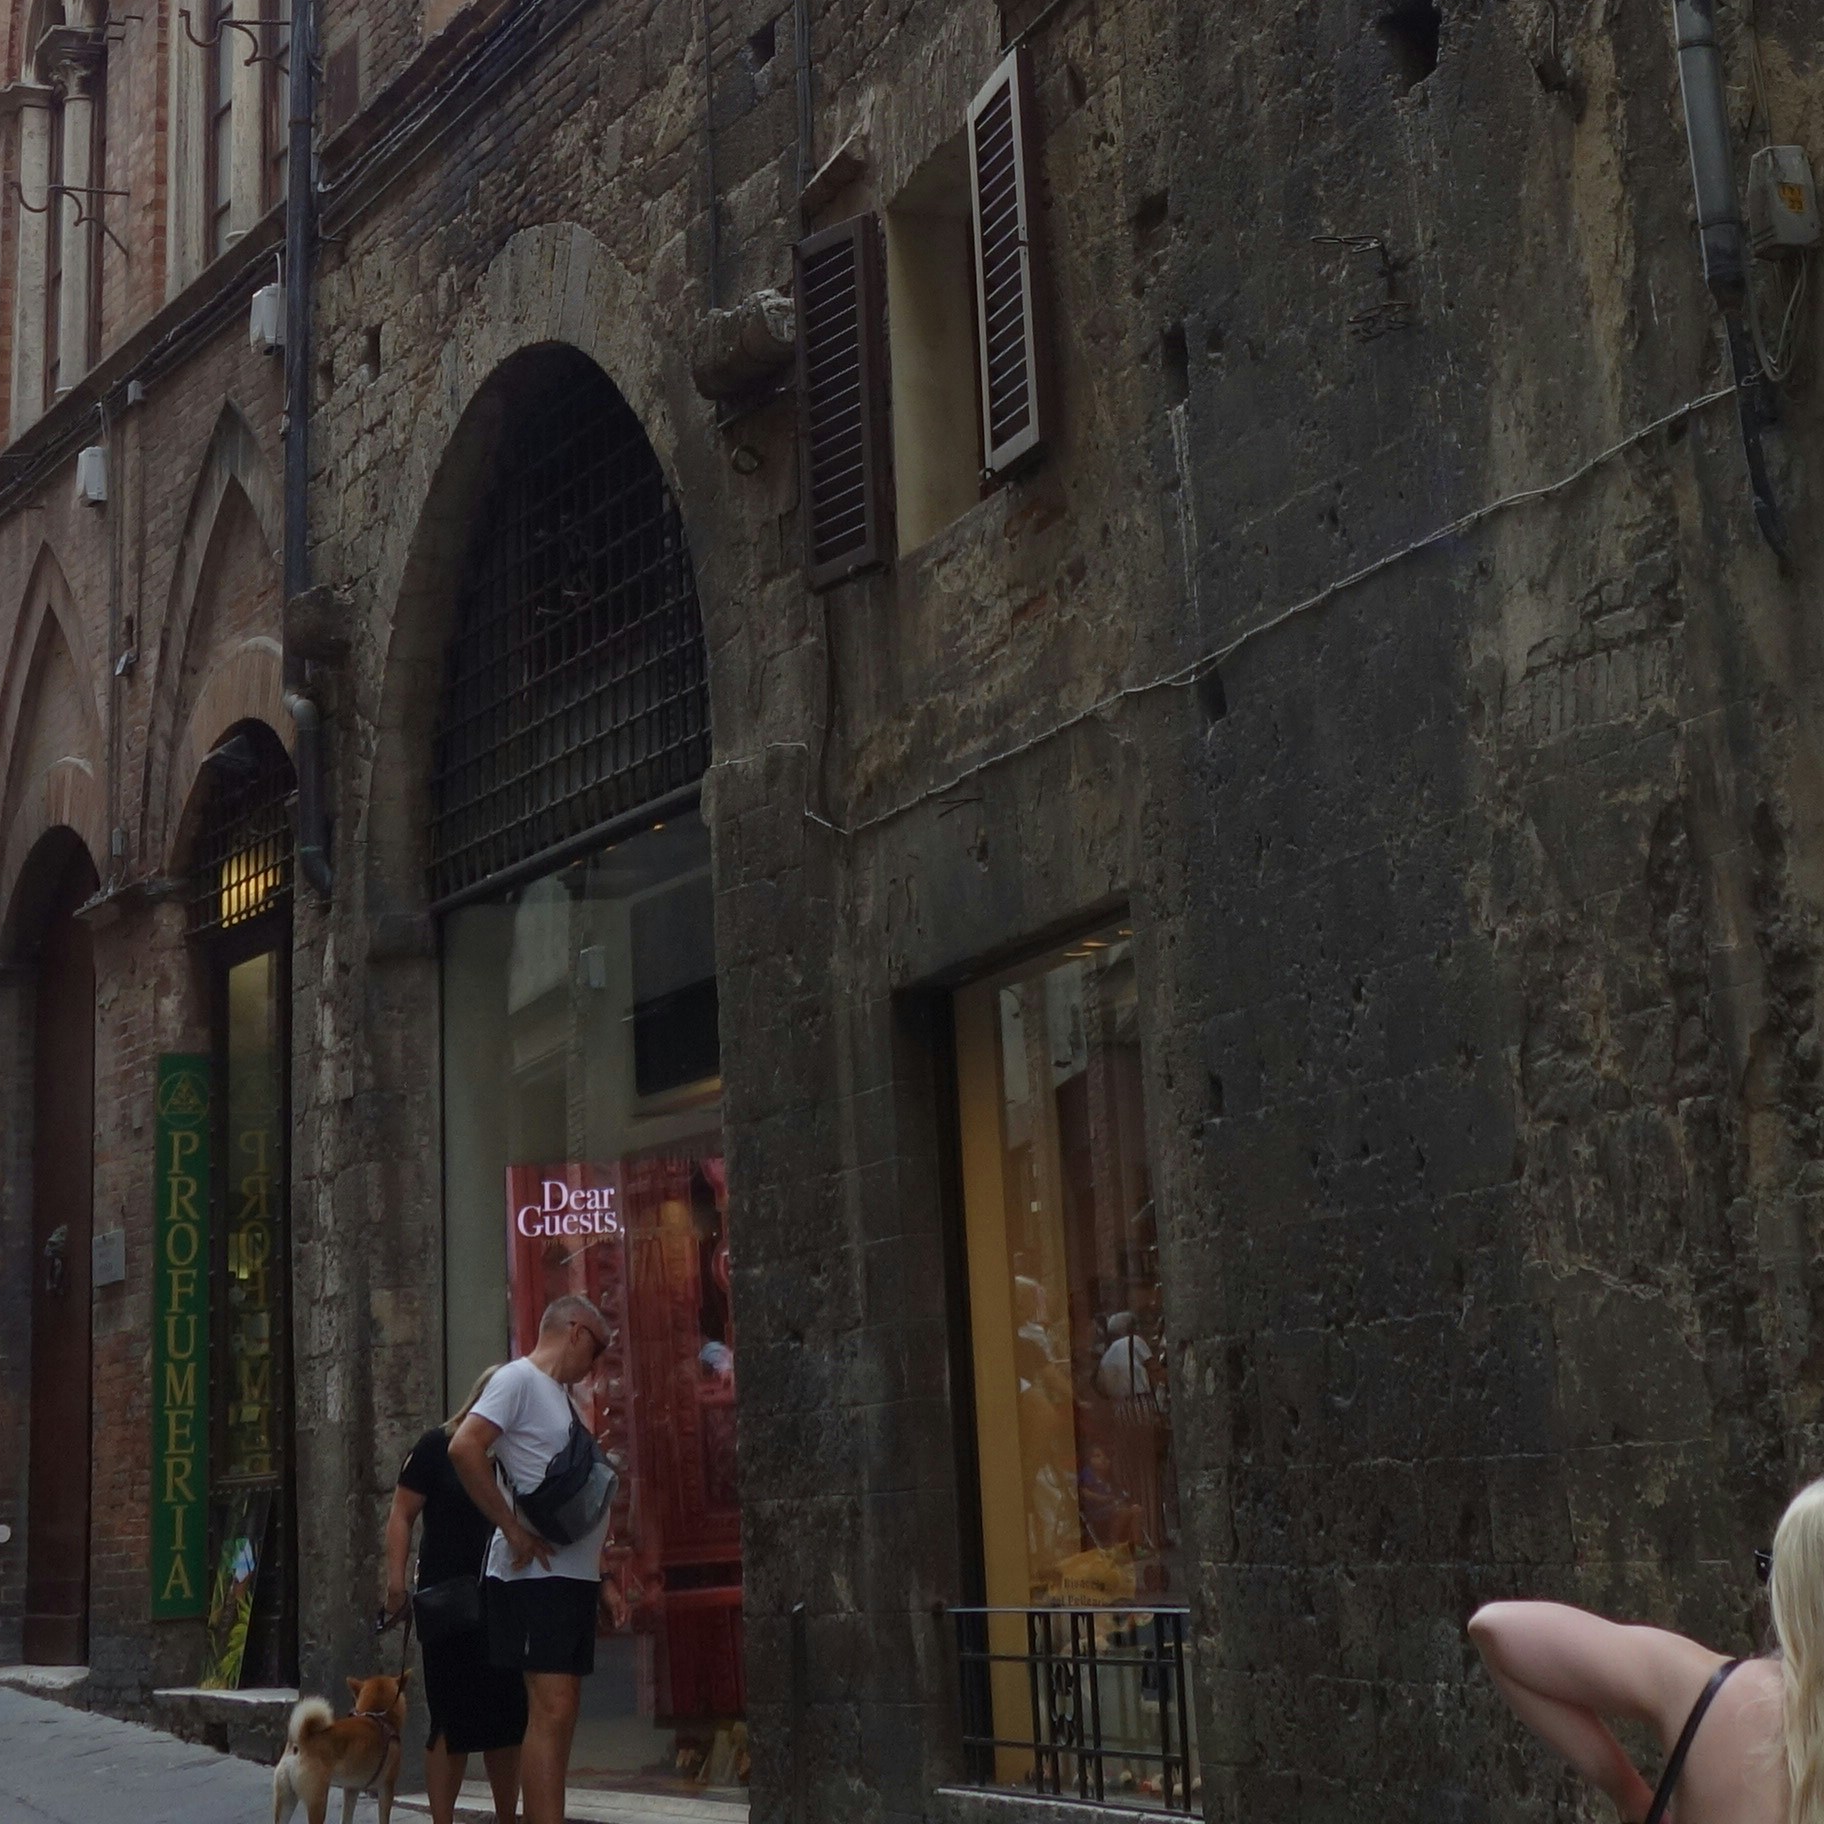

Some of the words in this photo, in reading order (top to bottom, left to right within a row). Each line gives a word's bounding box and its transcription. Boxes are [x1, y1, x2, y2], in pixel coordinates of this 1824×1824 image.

[540, 1180, 616, 1212] Dear
[516, 1203, 626, 1240] Guests,
[159, 1130, 200, 1600] PROFUMERIA
